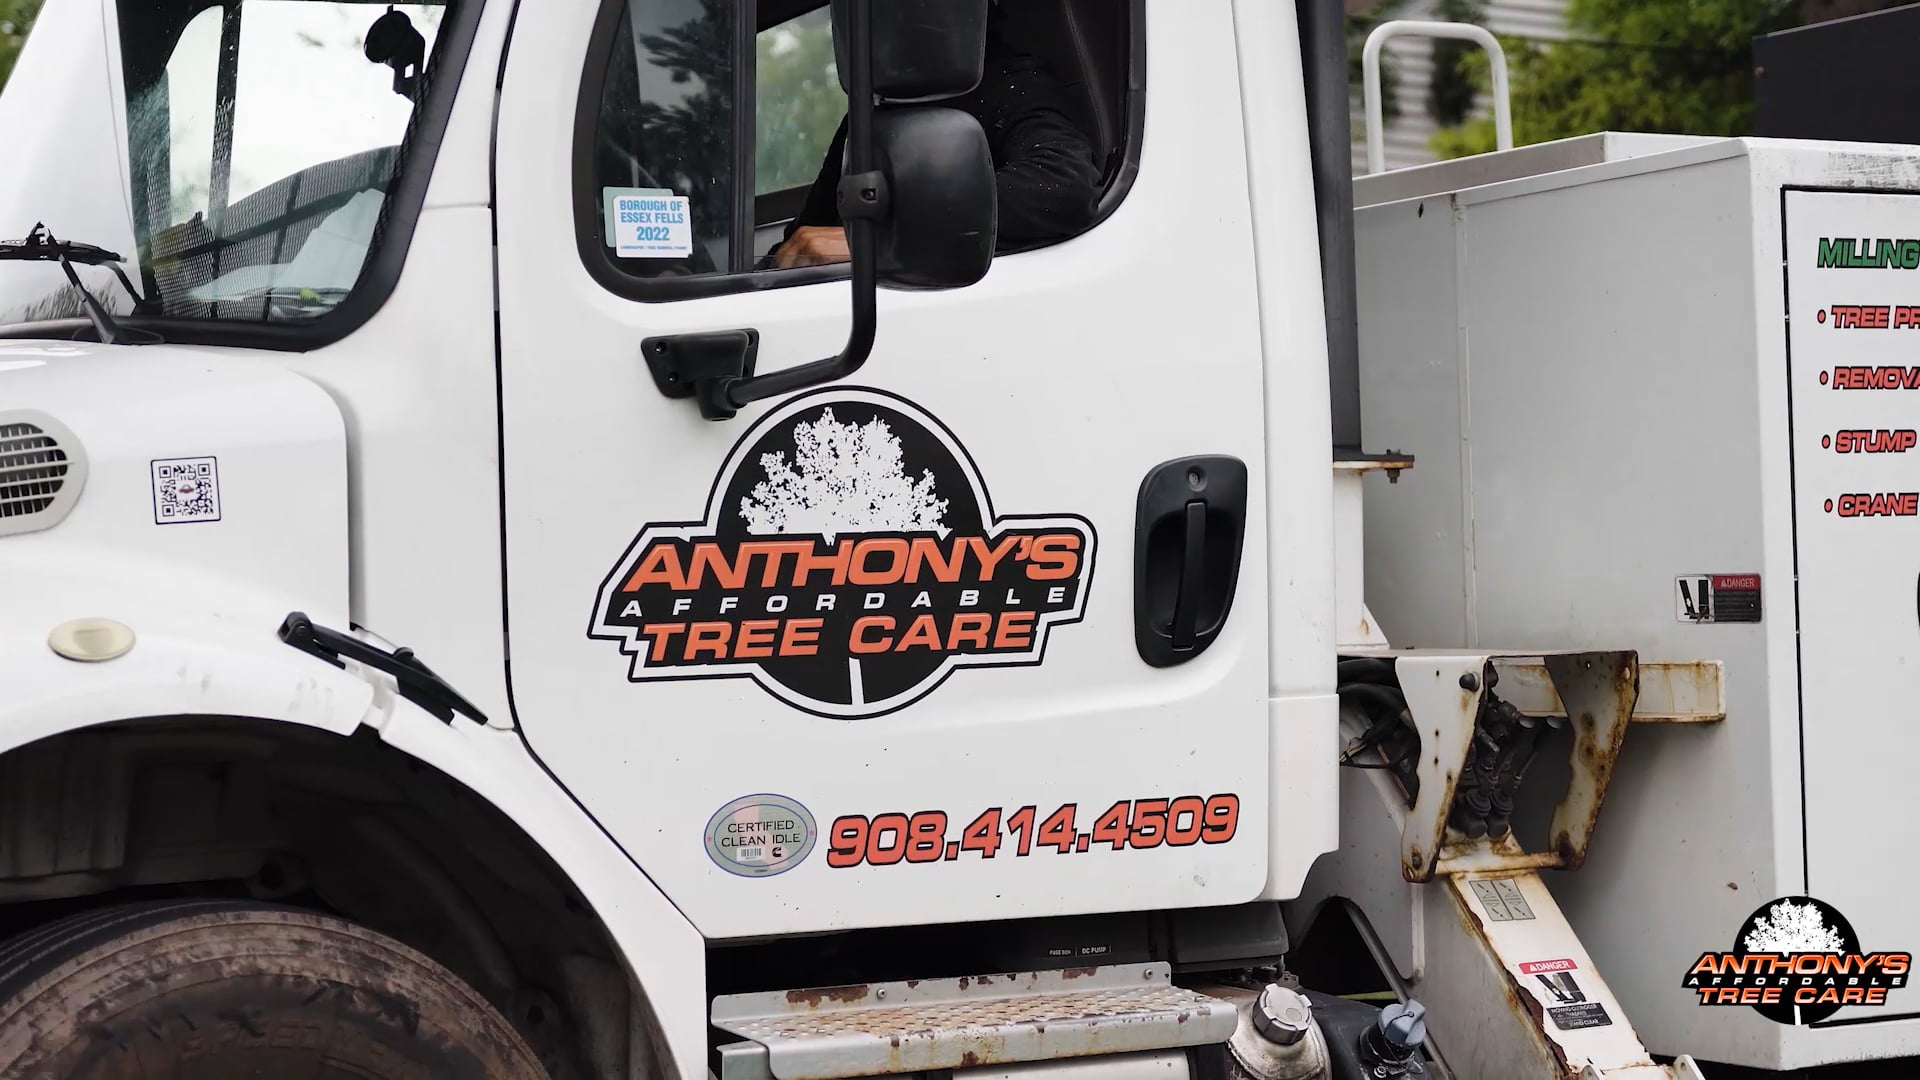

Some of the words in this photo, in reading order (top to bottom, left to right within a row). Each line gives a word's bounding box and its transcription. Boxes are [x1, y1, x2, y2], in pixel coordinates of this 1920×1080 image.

[619, 199, 667, 212] BOROUGH
[670, 200, 683, 212] OF
[620, 211, 652, 223] ESSEX
[655, 212, 684, 224] FELLS
[636, 226, 670, 241] 2022
[1831, 305, 1890, 328] TREE
[1835, 429, 1918, 453] STUMP
[1838, 492, 1920, 518] CRANE
[620, 532, 1081, 593] ANTHONY'S
[1726, 578, 1755, 588] DANGER
[619, 586, 1066, 618] AFFORDABLE
[642, 617, 825, 662] TREE
[848, 610, 1038, 655] CARE
[727, 819, 795, 834] CERTIFIED
[826, 793, 1240, 868] 908.414.4509
[721, 834, 767, 848] CLEAN
[772, 832, 801, 845] IDLE
[1537, 960, 1571, 972] DANGER
